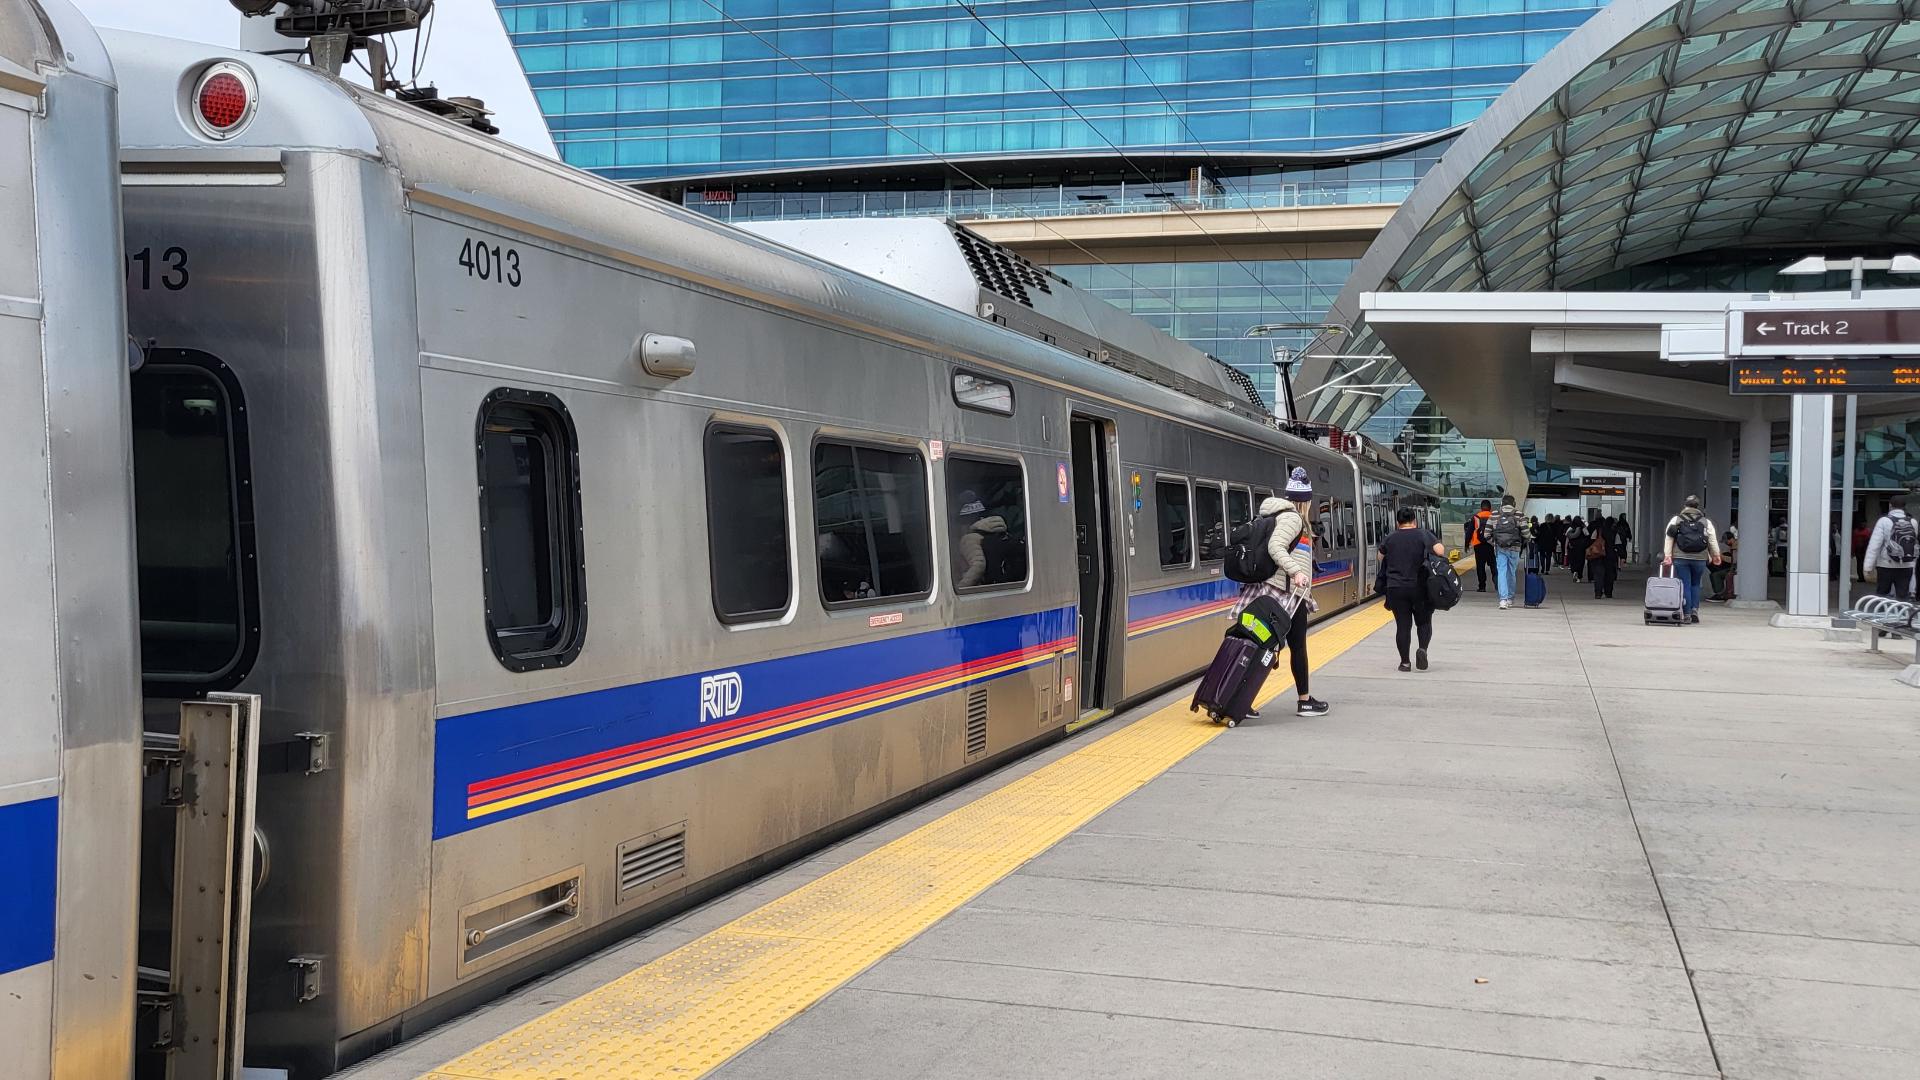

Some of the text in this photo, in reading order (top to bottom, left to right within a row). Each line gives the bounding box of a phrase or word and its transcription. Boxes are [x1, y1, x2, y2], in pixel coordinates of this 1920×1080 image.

[125, 246, 189, 291] 13
[459, 237, 522, 288] 4013
[1782, 320, 1849, 336] Track 2
[700, 671, 742, 723] RTD
